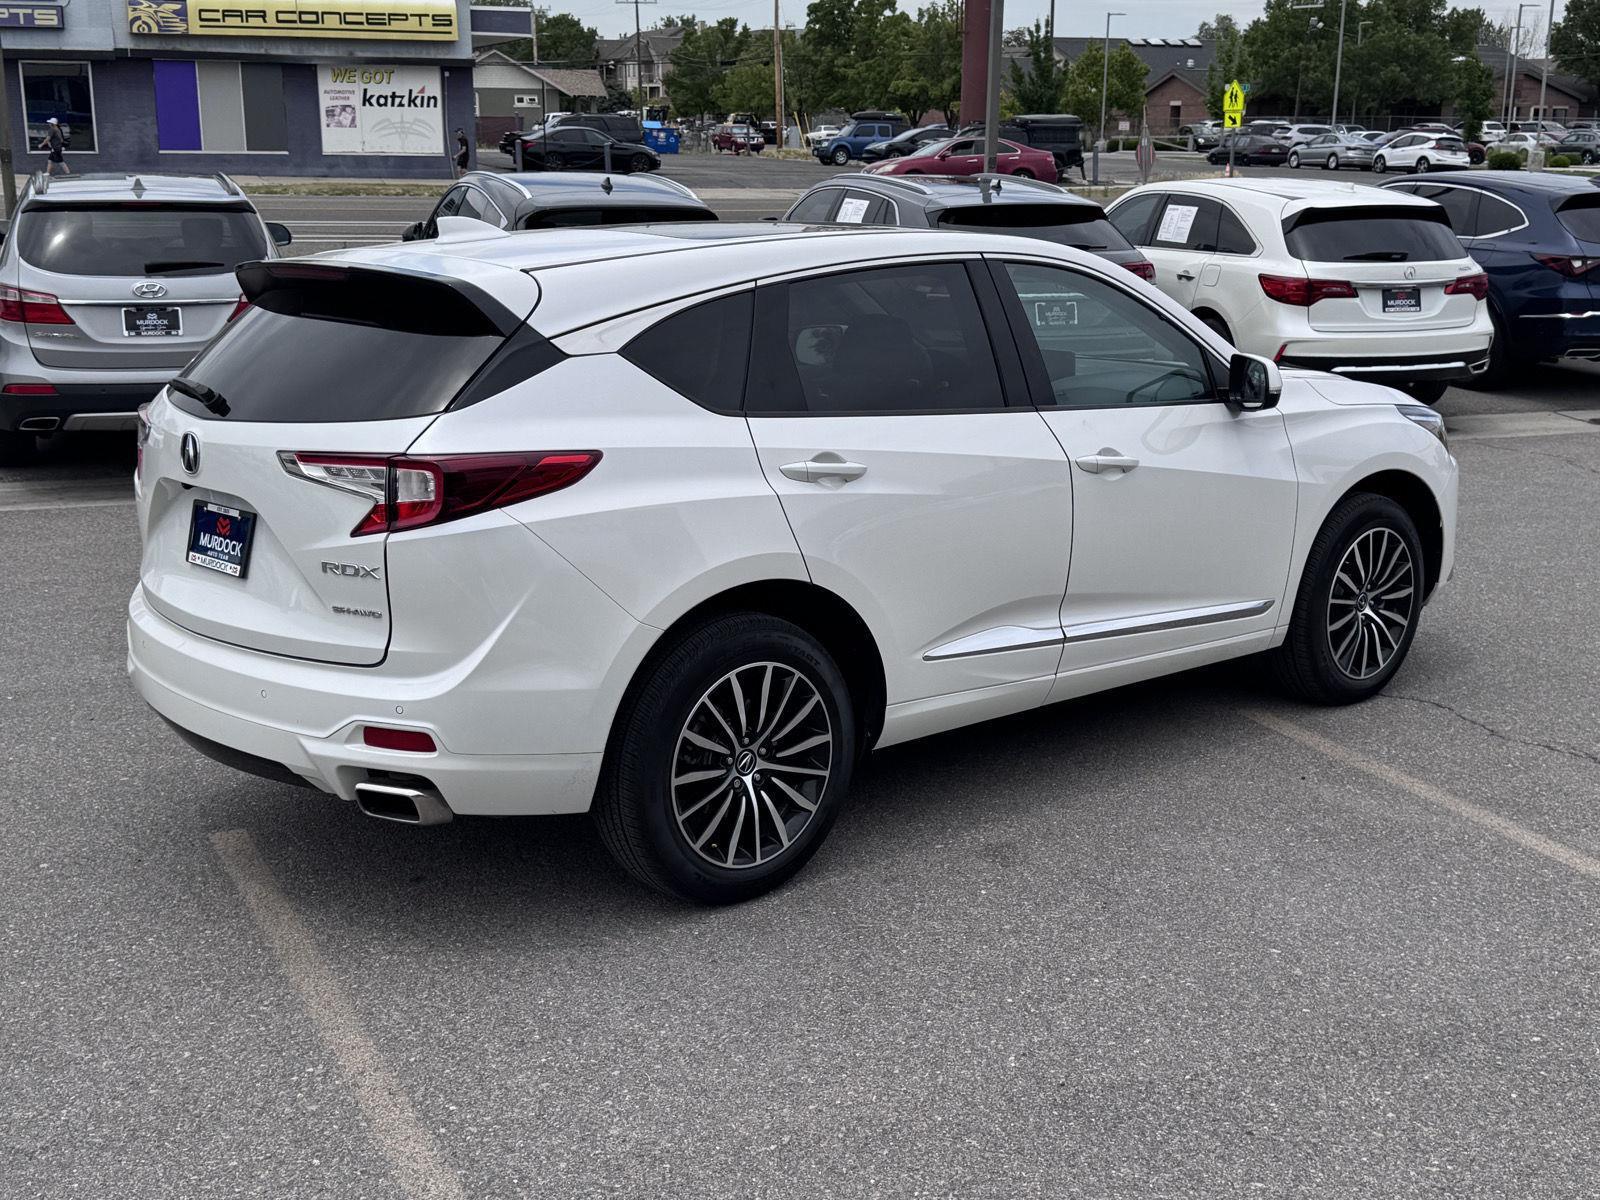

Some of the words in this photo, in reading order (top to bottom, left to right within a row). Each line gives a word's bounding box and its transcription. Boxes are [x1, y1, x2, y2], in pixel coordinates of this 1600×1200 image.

[198, 9, 267, 24] CAR
[275, 10, 453, 27] CONCEPTS
[331, 68, 357, 83] WE
[360, 69, 395, 84] GOT
[362, 85, 438, 108] katzkin
[199, 531, 243, 557] MURDOCK
[321, 560, 381, 580] RDX
